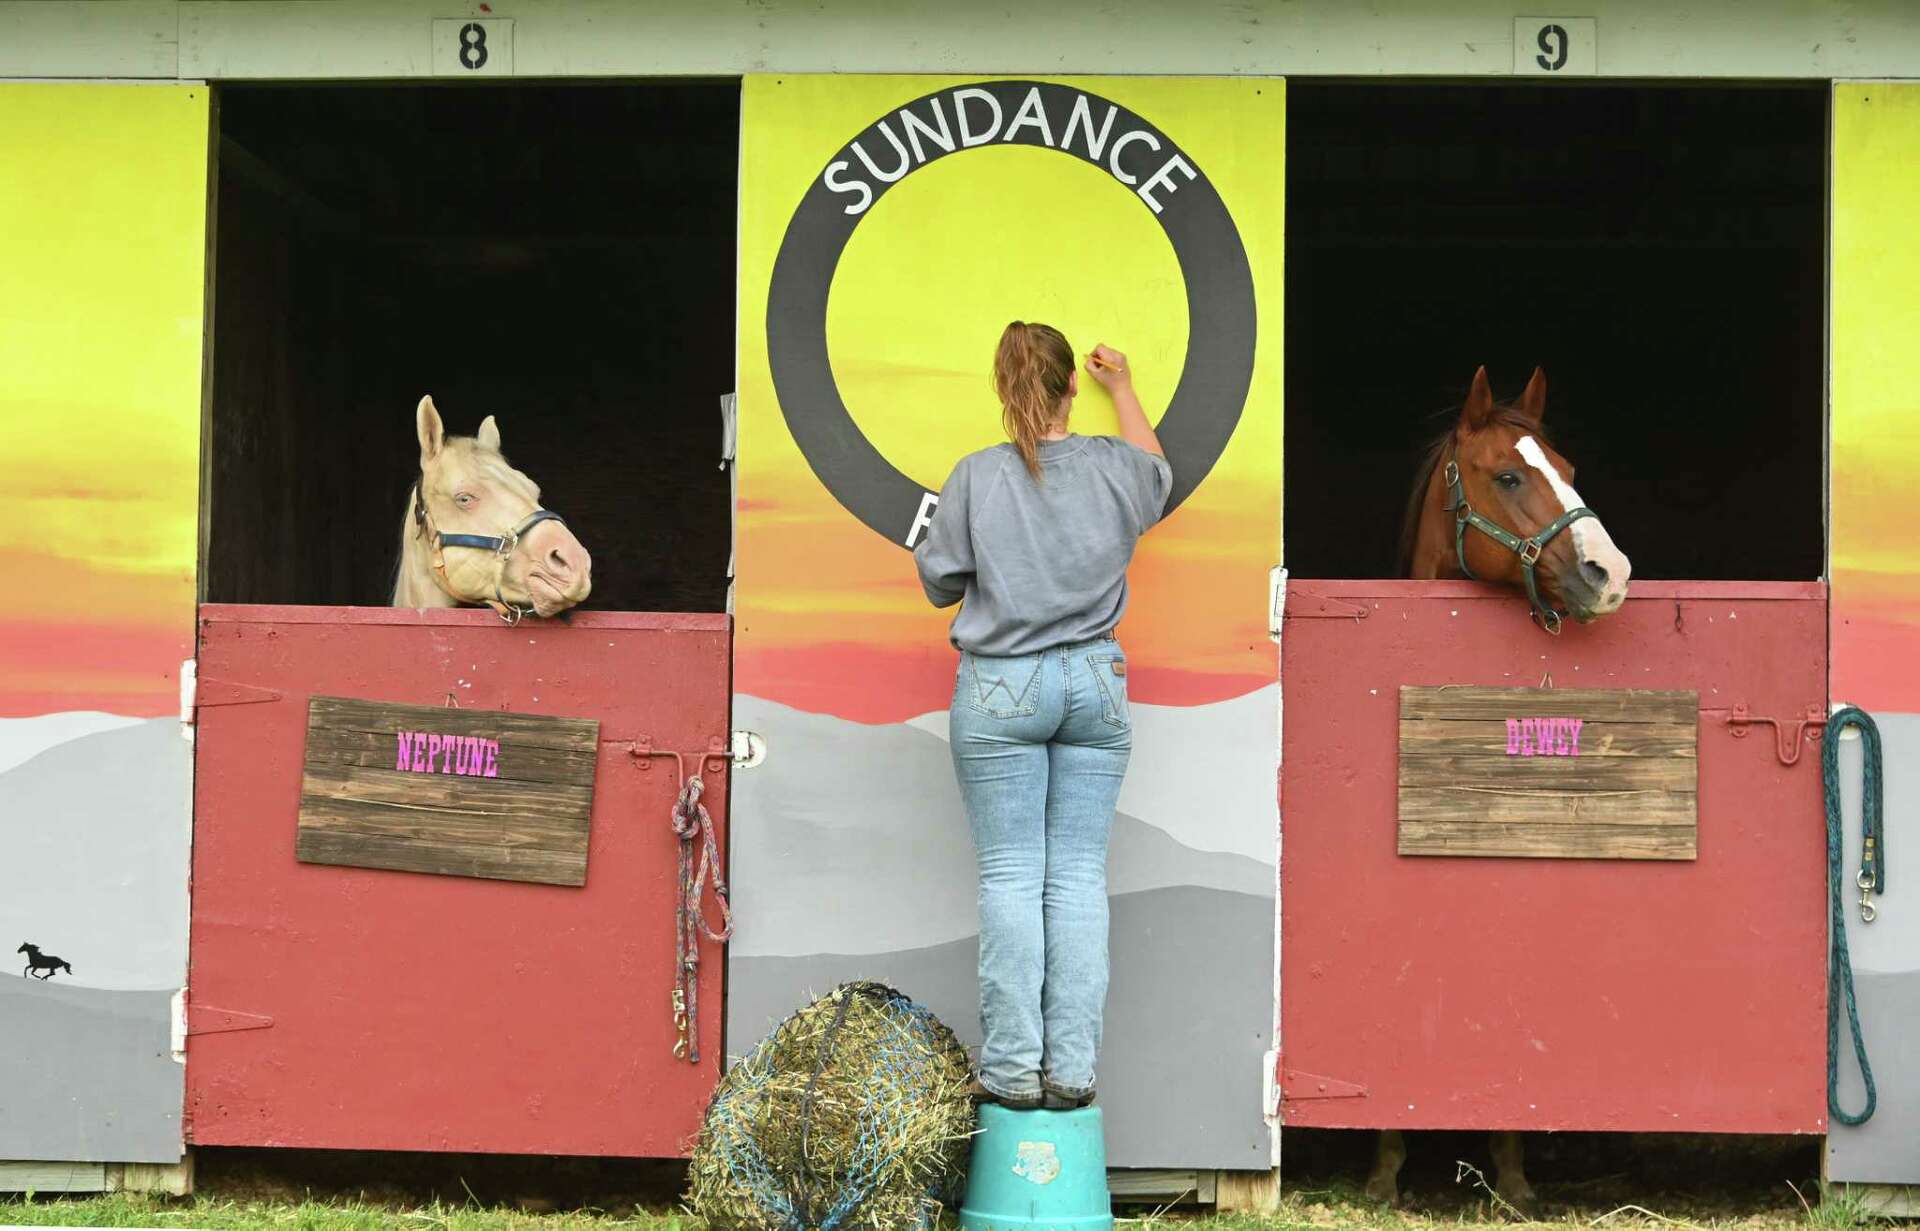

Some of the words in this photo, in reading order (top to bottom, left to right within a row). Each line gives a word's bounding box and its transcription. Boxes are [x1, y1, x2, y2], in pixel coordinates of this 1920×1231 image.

[459, 23, 488, 69] 8
[1537, 24, 1568, 71] 9
[824, 87, 1197, 215] SUNDANCE
[397, 731, 500, 778] NEPTUNE
[1506, 717, 1583, 756] DEWEY
